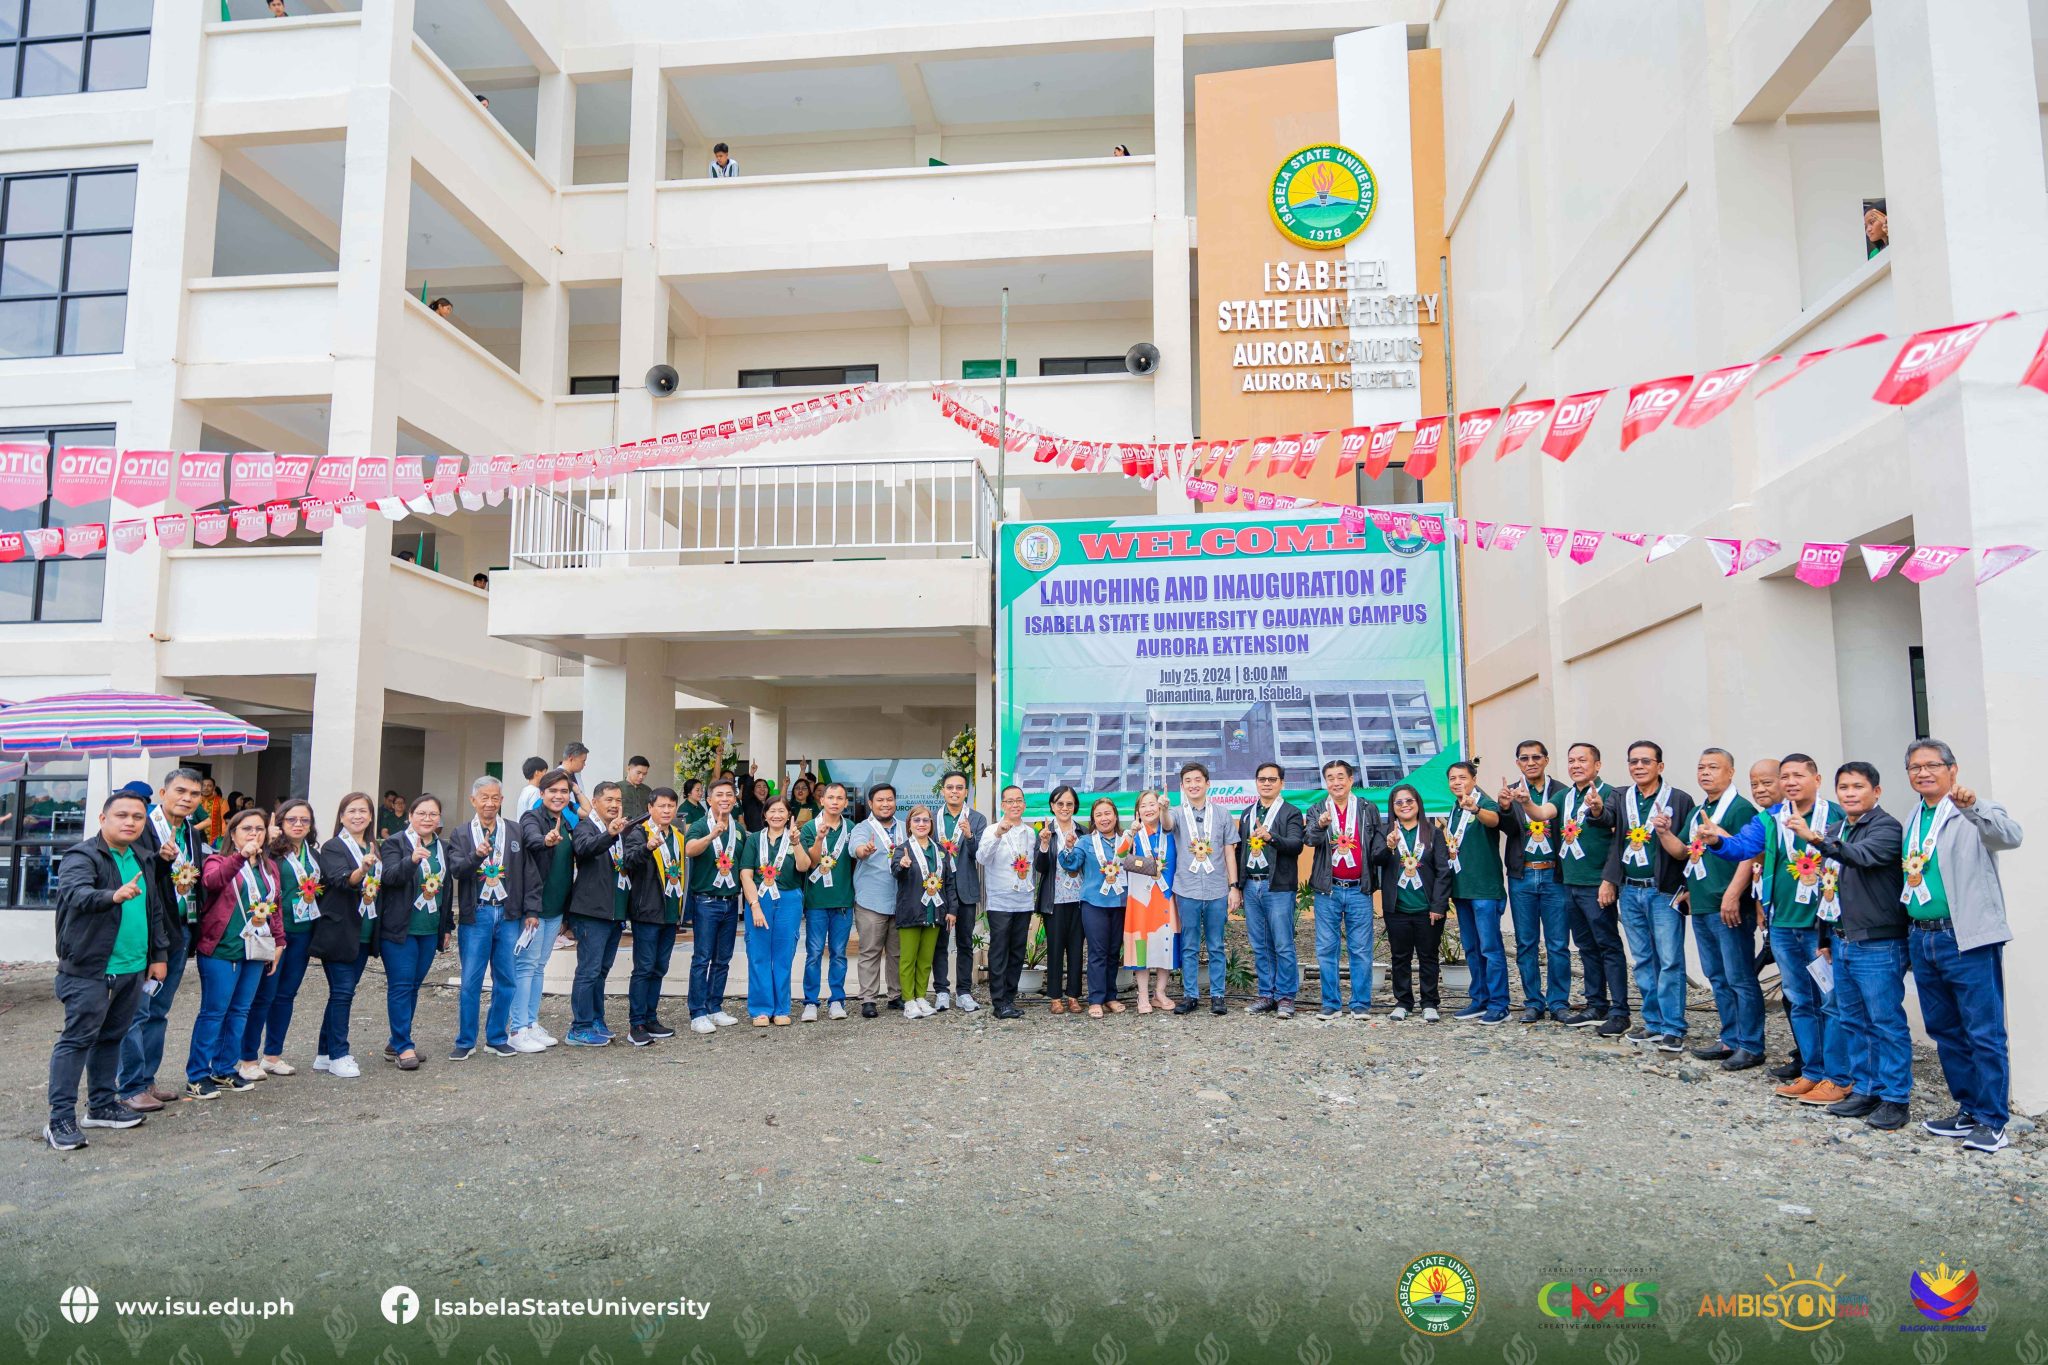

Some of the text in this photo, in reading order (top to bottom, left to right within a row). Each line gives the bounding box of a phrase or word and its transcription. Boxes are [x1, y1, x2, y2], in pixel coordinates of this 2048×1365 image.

[1275, 149, 1371, 226] ISABELA STATE UNIVERSITY
[1309, 228, 1341, 240] 1978
[1218, 293, 1439, 331] STATE UNIVERSITY
[1233, 337, 1423, 367] AURORA CAMPUS
[1900, 322, 1988, 369] DITO
[1695, 363, 1760, 399] DITO
[1555, 397, 1602, 425] DITO
[1627, 388, 1680, 417] DITO
[1459, 418, 1493, 439] DITO
[1504, 410, 1545, 431] DITO
[1415, 424, 1441, 445] DITO
[1274, 440, 1300, 454] DITO
[1200, 482, 1217, 492] DITO
[1275, 499, 1294, 509] DITO
[1344, 507, 1364, 518] DITO
[1370, 512, 1390, 521] DITO
[1420, 519, 1440, 529] DITO
[1079, 523, 1366, 560] WELCOME
[1573, 534, 1598, 547] DITO
[1803, 548, 1841, 564] DITO
[1040, 568, 1407, 605] LAUNCHING AND INAUGURATION OF
[1025, 603, 1428, 634] ISABELA STATE UNIVERSITY CAUAYAN CAMPUS
[1136, 633, 1309, 657] AURORA EXTENSION
[1159, 669, 1182, 684] July
[1183, 668, 1200, 684] 25,
[1202, 667, 1231, 683] 2024
[1242, 666, 1268, 682] 8:00
[1270, 665, 1288, 681] AM
[1145, 685, 1303, 703] Diamantina, Aurora, Isabela
